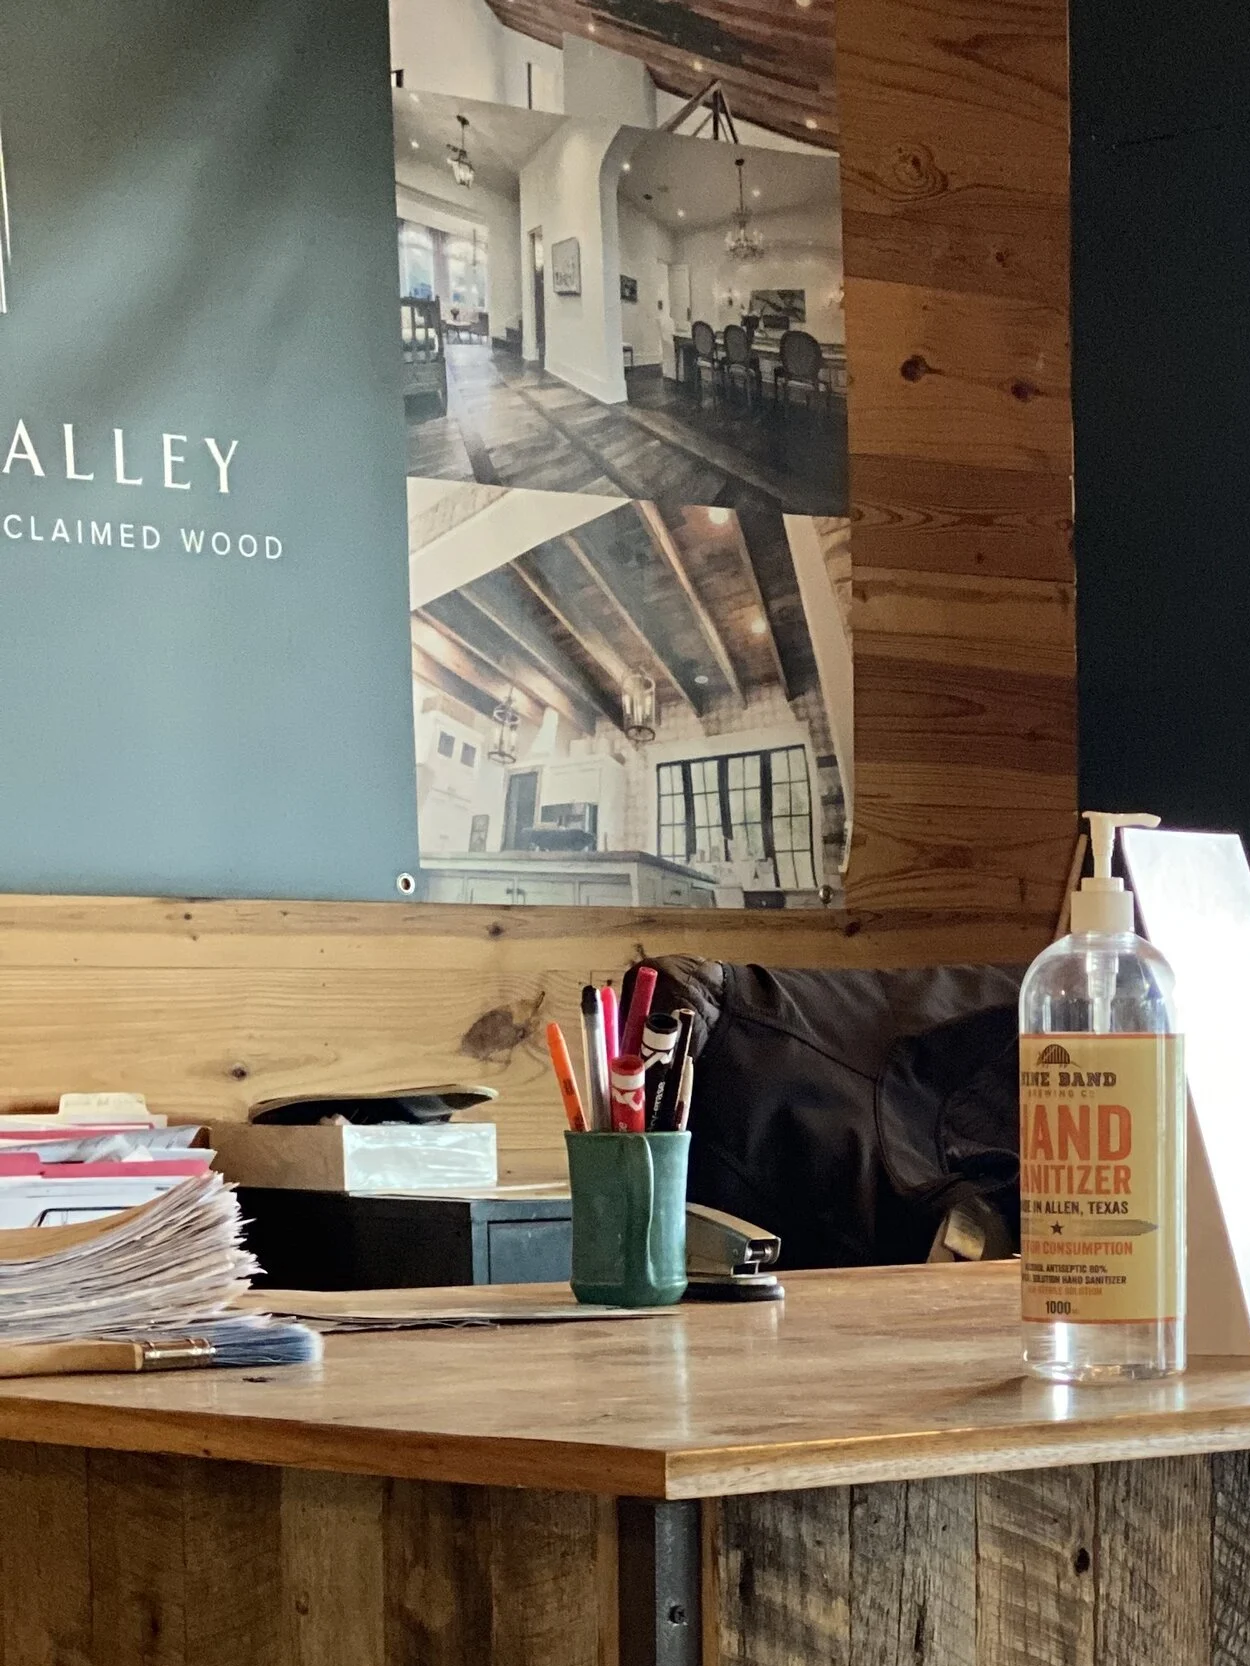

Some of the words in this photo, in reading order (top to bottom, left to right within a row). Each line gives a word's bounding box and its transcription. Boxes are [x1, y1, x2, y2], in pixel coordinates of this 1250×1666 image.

[2, 418, 239, 494] ALLEY
[3, 514, 161, 550] CLAIMED
[180, 528, 283, 560] WOOD
[1058, 1071, 1117, 1087] BAND
[1087, 1201, 1129, 1215] TEXAS
[1042, 1241, 1133, 1255] CONSUMPTION
[1085, 1275, 1127, 1284] SANITIZER
[1045, 1300, 1071, 1314] 1000
